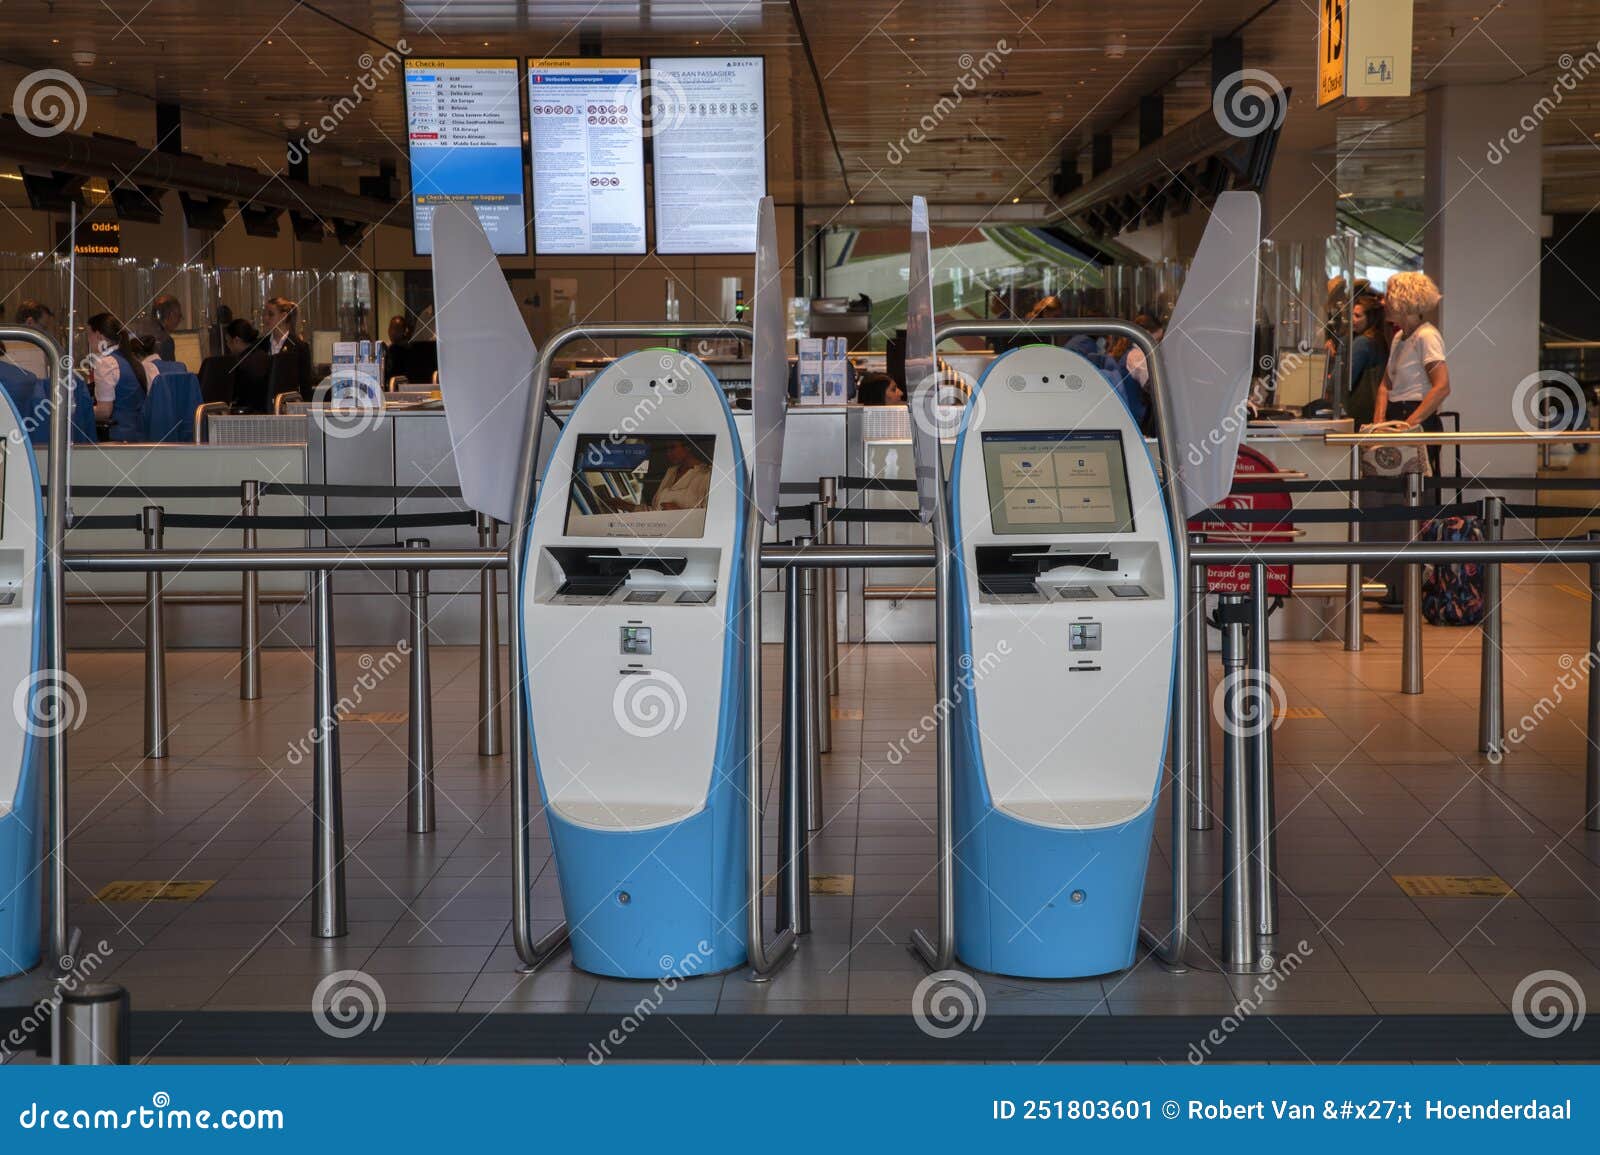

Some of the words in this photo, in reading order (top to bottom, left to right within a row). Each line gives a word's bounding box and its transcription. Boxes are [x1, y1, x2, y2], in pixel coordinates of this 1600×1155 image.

[415, 60, 445, 68] Check-in
[74, 245, 119, 253] Assistance
[1207, 569, 1236, 577] brand
[1208, 582, 1238, 591] gency
